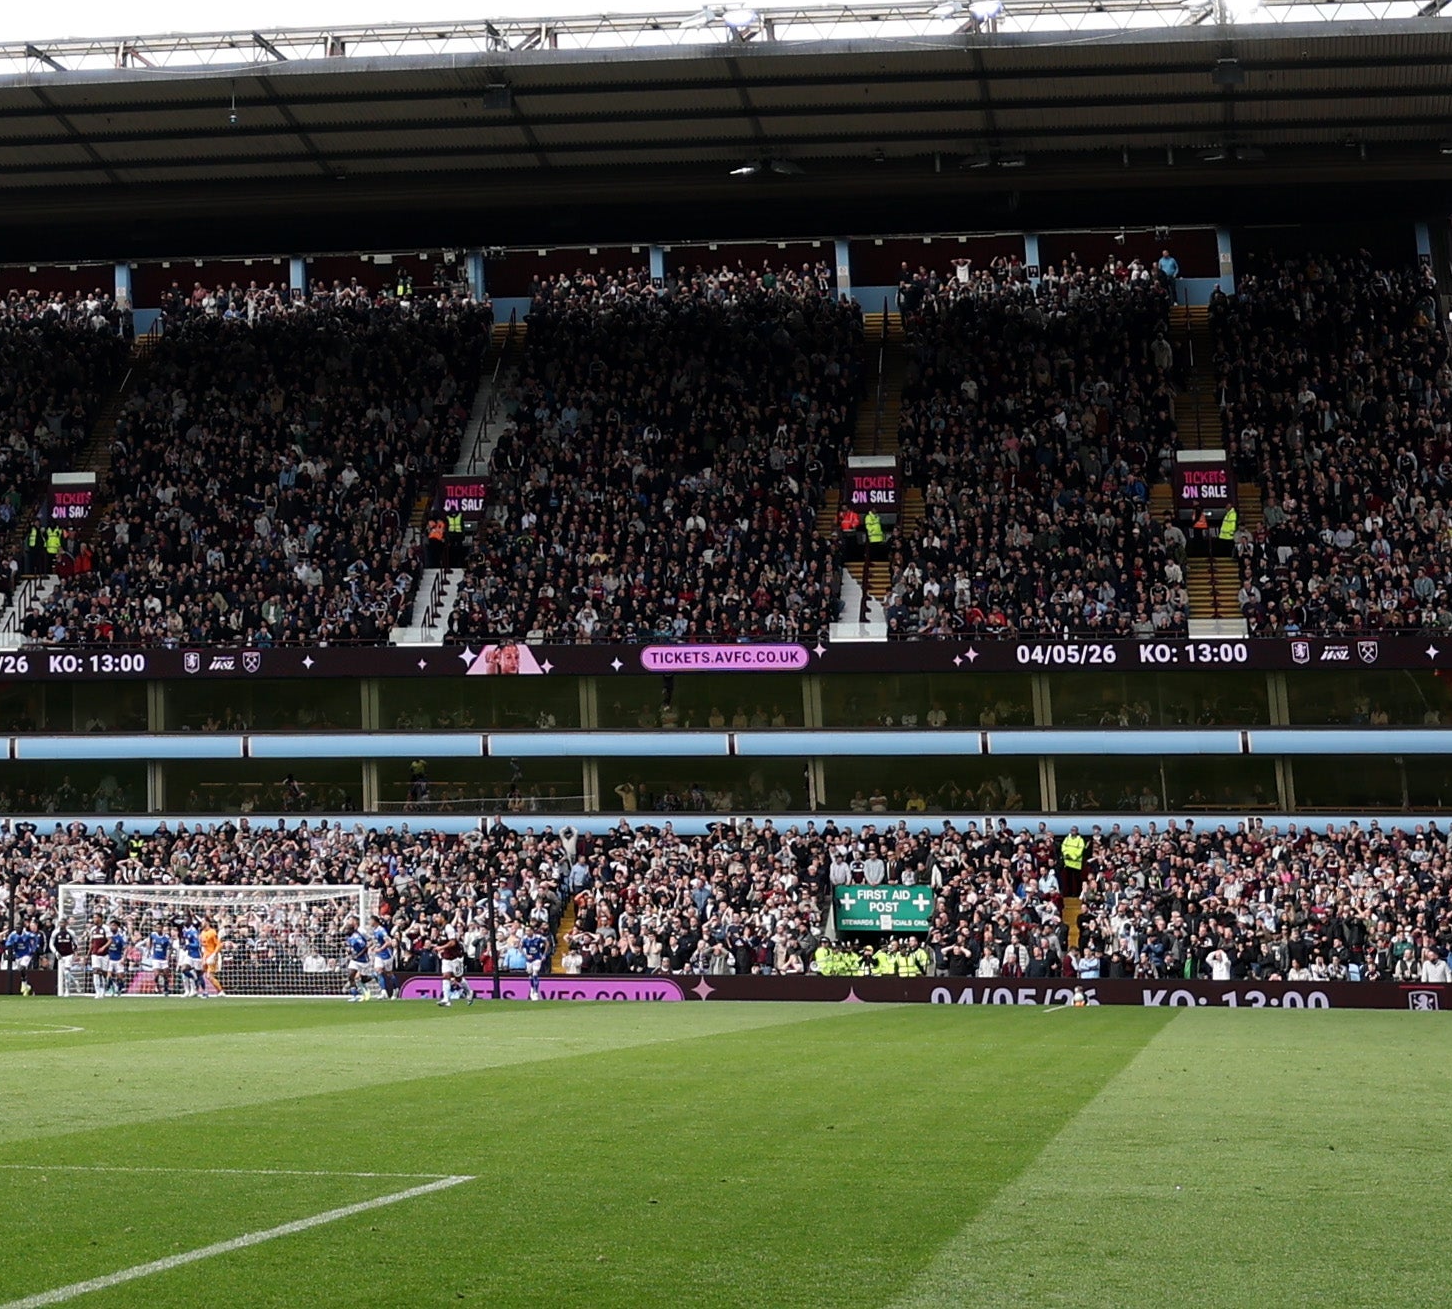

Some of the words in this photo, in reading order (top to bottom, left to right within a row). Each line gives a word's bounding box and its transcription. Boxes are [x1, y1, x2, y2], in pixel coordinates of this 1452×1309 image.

[853, 476, 895, 489] TICKETS
[1183, 471, 1227, 484] TICKETS
[446, 484, 485, 497] TICKETS
[852, 491, 868, 503] ON
[869, 490, 895, 503] SALE
[1182, 485, 1199, 498] ON
[1200, 484, 1227, 498] SALE
[52, 505, 67, 519] ON
[650, 651, 799, 664] TICKETS.AVFC.CO.UK
[1017, 644, 1117, 665] 04/05/26
[1139, 643, 1179, 663] KO:
[1184, 643, 1249, 662] 13:00
[49, 654, 84, 673] KO:
[90, 653, 145, 673] 13:00
[857, 889, 888, 900] FIRST
[891, 889, 911, 900] AID
[869, 902, 899, 913] POST
